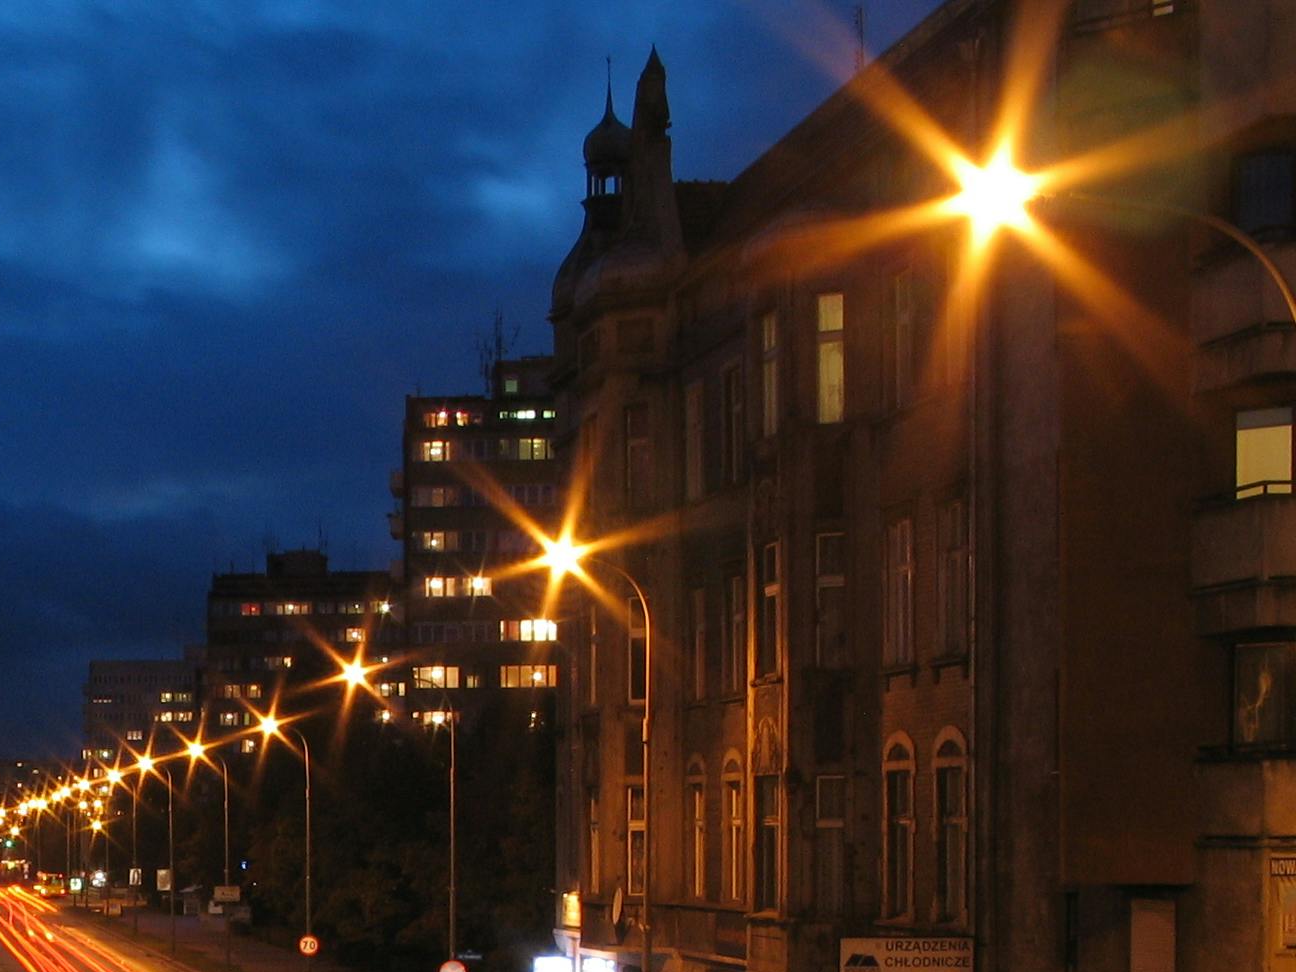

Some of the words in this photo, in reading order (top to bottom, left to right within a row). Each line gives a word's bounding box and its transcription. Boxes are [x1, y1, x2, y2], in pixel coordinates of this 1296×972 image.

[302, 940, 316, 950] 70
[885, 940, 971, 954] URZĄDZENIA
[883, 956, 971, 968] CHŁODNICZE
